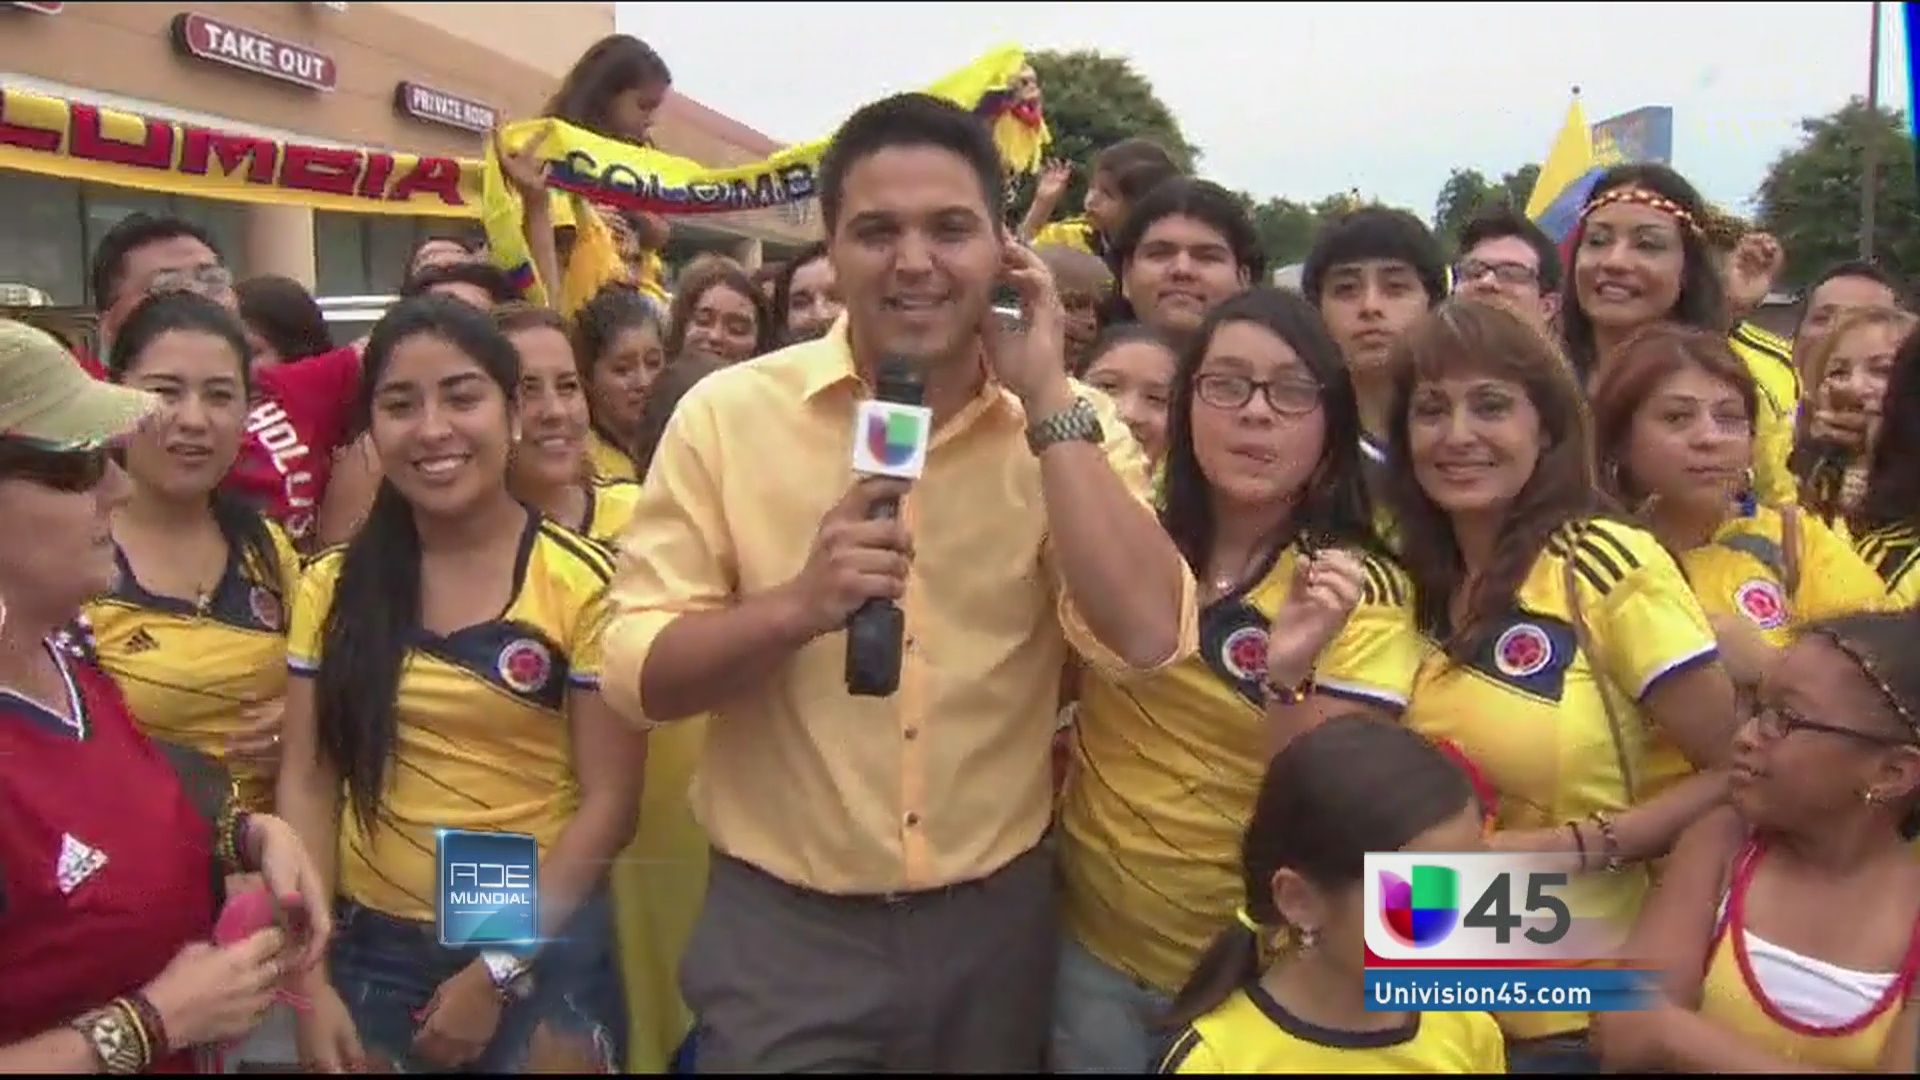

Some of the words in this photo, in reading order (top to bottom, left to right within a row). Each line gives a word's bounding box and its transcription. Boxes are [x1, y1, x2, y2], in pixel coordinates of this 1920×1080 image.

[204, 22, 275, 68] TAKE
[278, 48, 325, 80] OUT
[412, 87, 462, 121] PRIVATE
